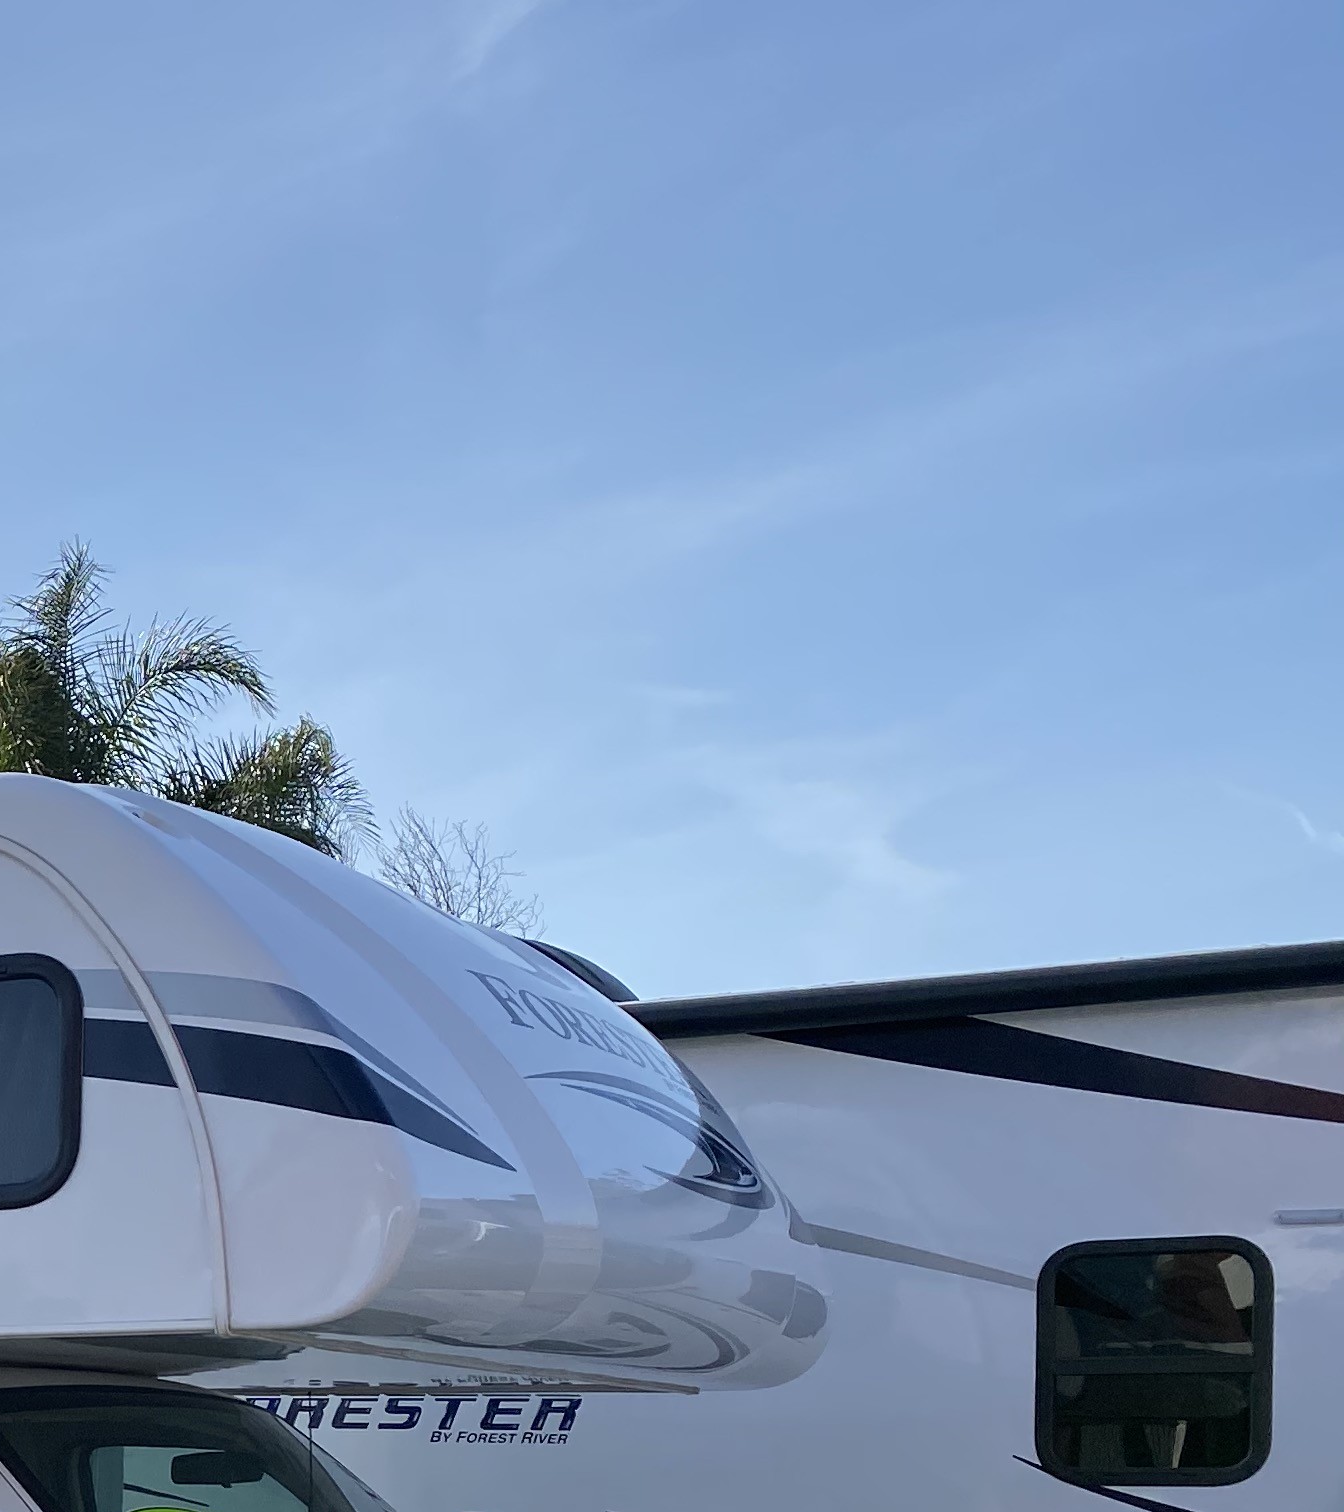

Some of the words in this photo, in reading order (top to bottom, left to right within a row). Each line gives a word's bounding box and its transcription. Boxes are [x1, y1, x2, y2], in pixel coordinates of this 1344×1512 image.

[430, 1431, 452, 1443] BY
[456, 1432, 517, 1444] FOREST
[521, 1432, 569, 1445] RIVER
